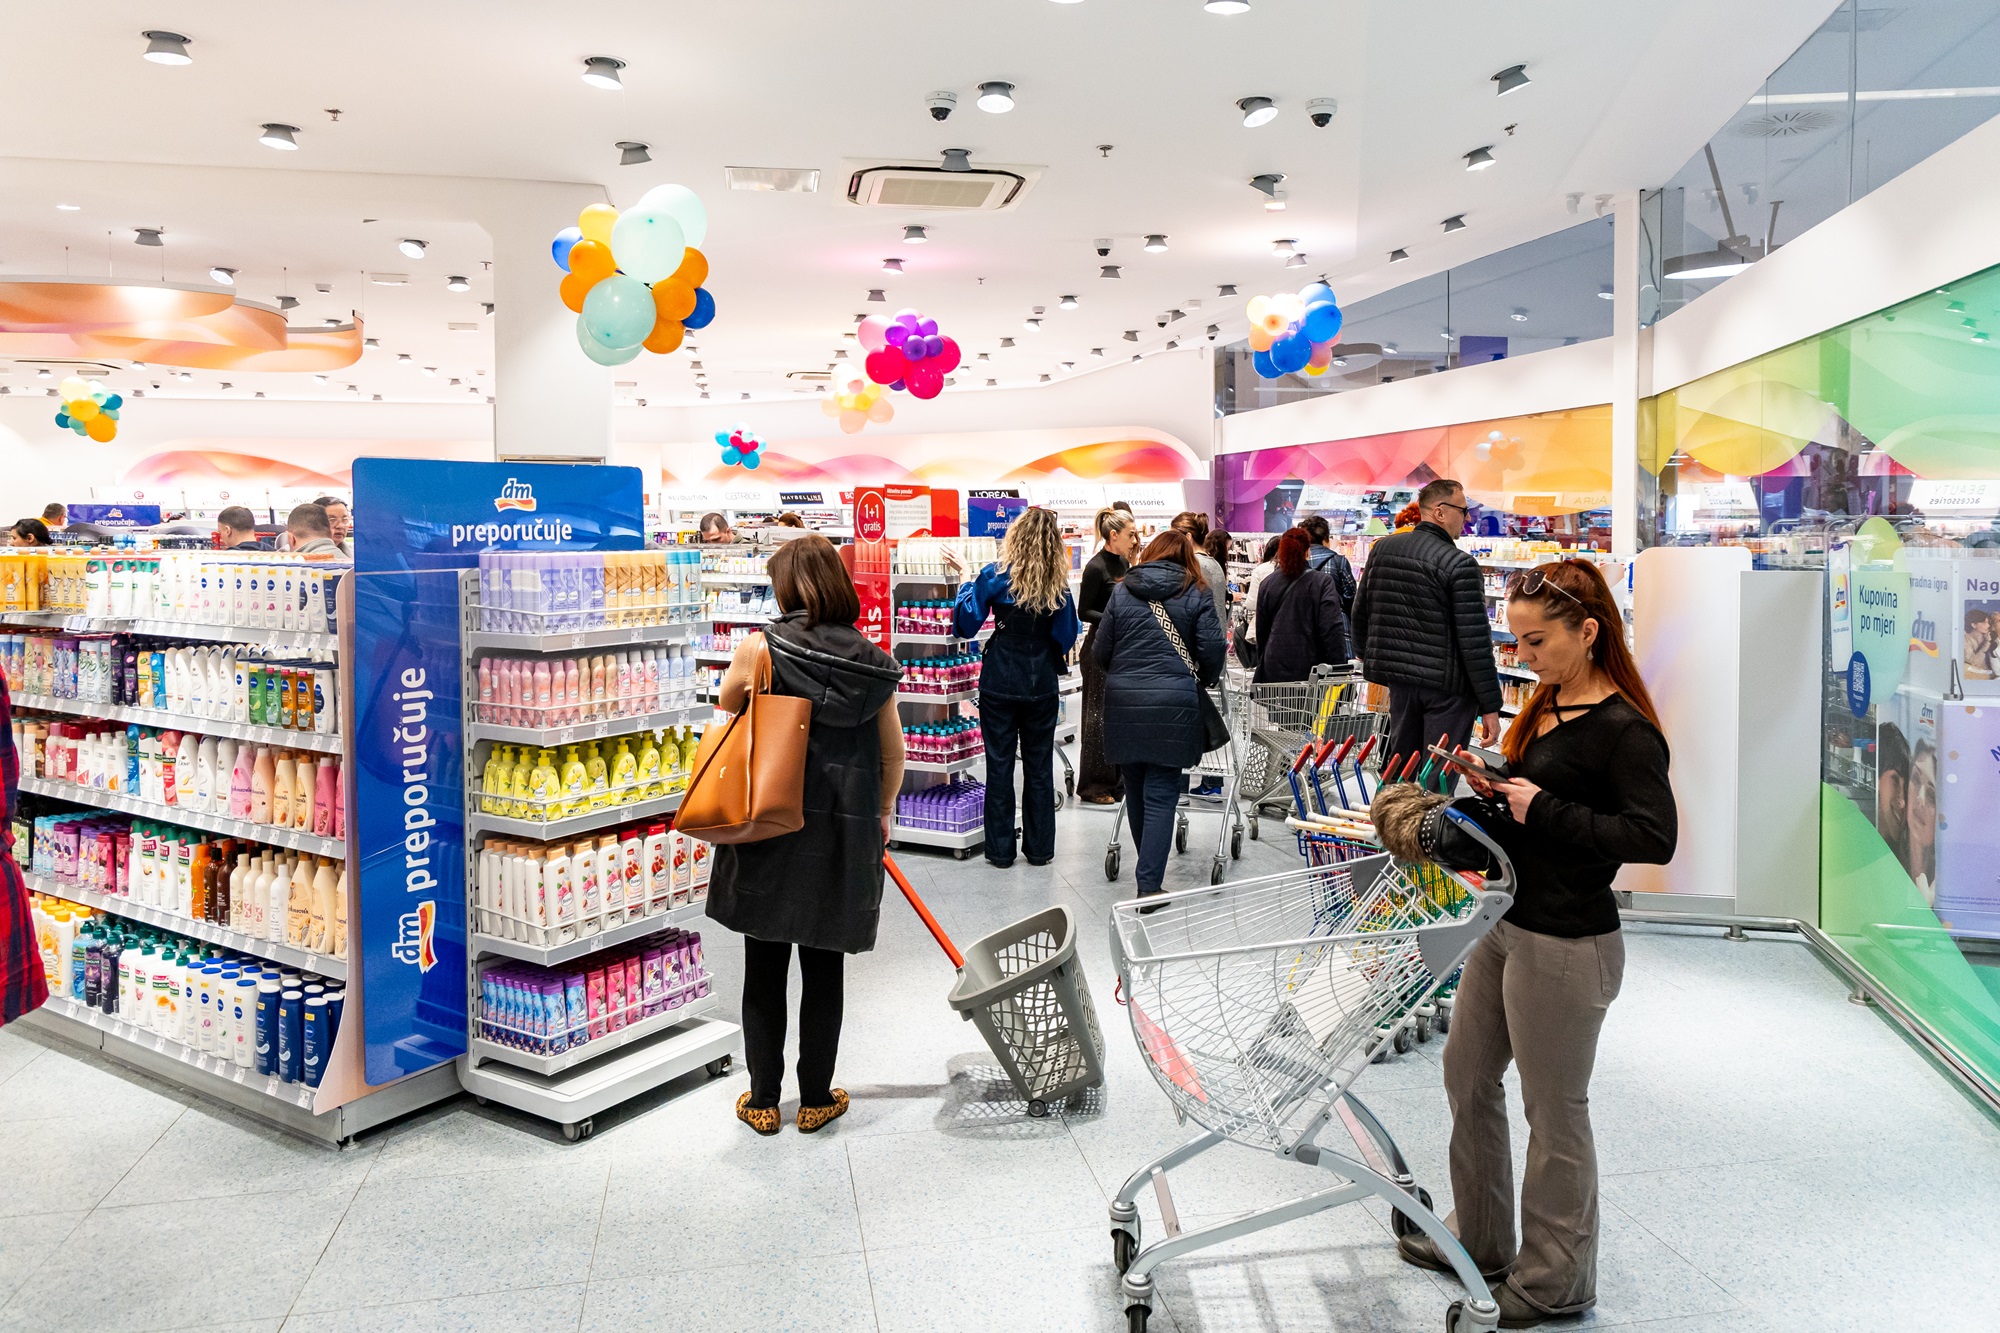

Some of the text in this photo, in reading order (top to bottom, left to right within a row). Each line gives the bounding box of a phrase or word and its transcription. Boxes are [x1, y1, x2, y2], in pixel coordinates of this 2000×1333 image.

[501, 477, 533, 500] dm
[864, 503, 880, 519] 1+1
[452, 518, 573, 548] preporučuje
[863, 521, 882, 533] gratis
[1859, 584, 1898, 609] Kupovina
[1933, 576, 1948, 592] igra
[1860, 614, 1871, 633] po
[1873, 613, 1896, 638] mjeri
[1911, 610, 1936, 641] dm
[391, 667, 438, 966] dm preporučuje
